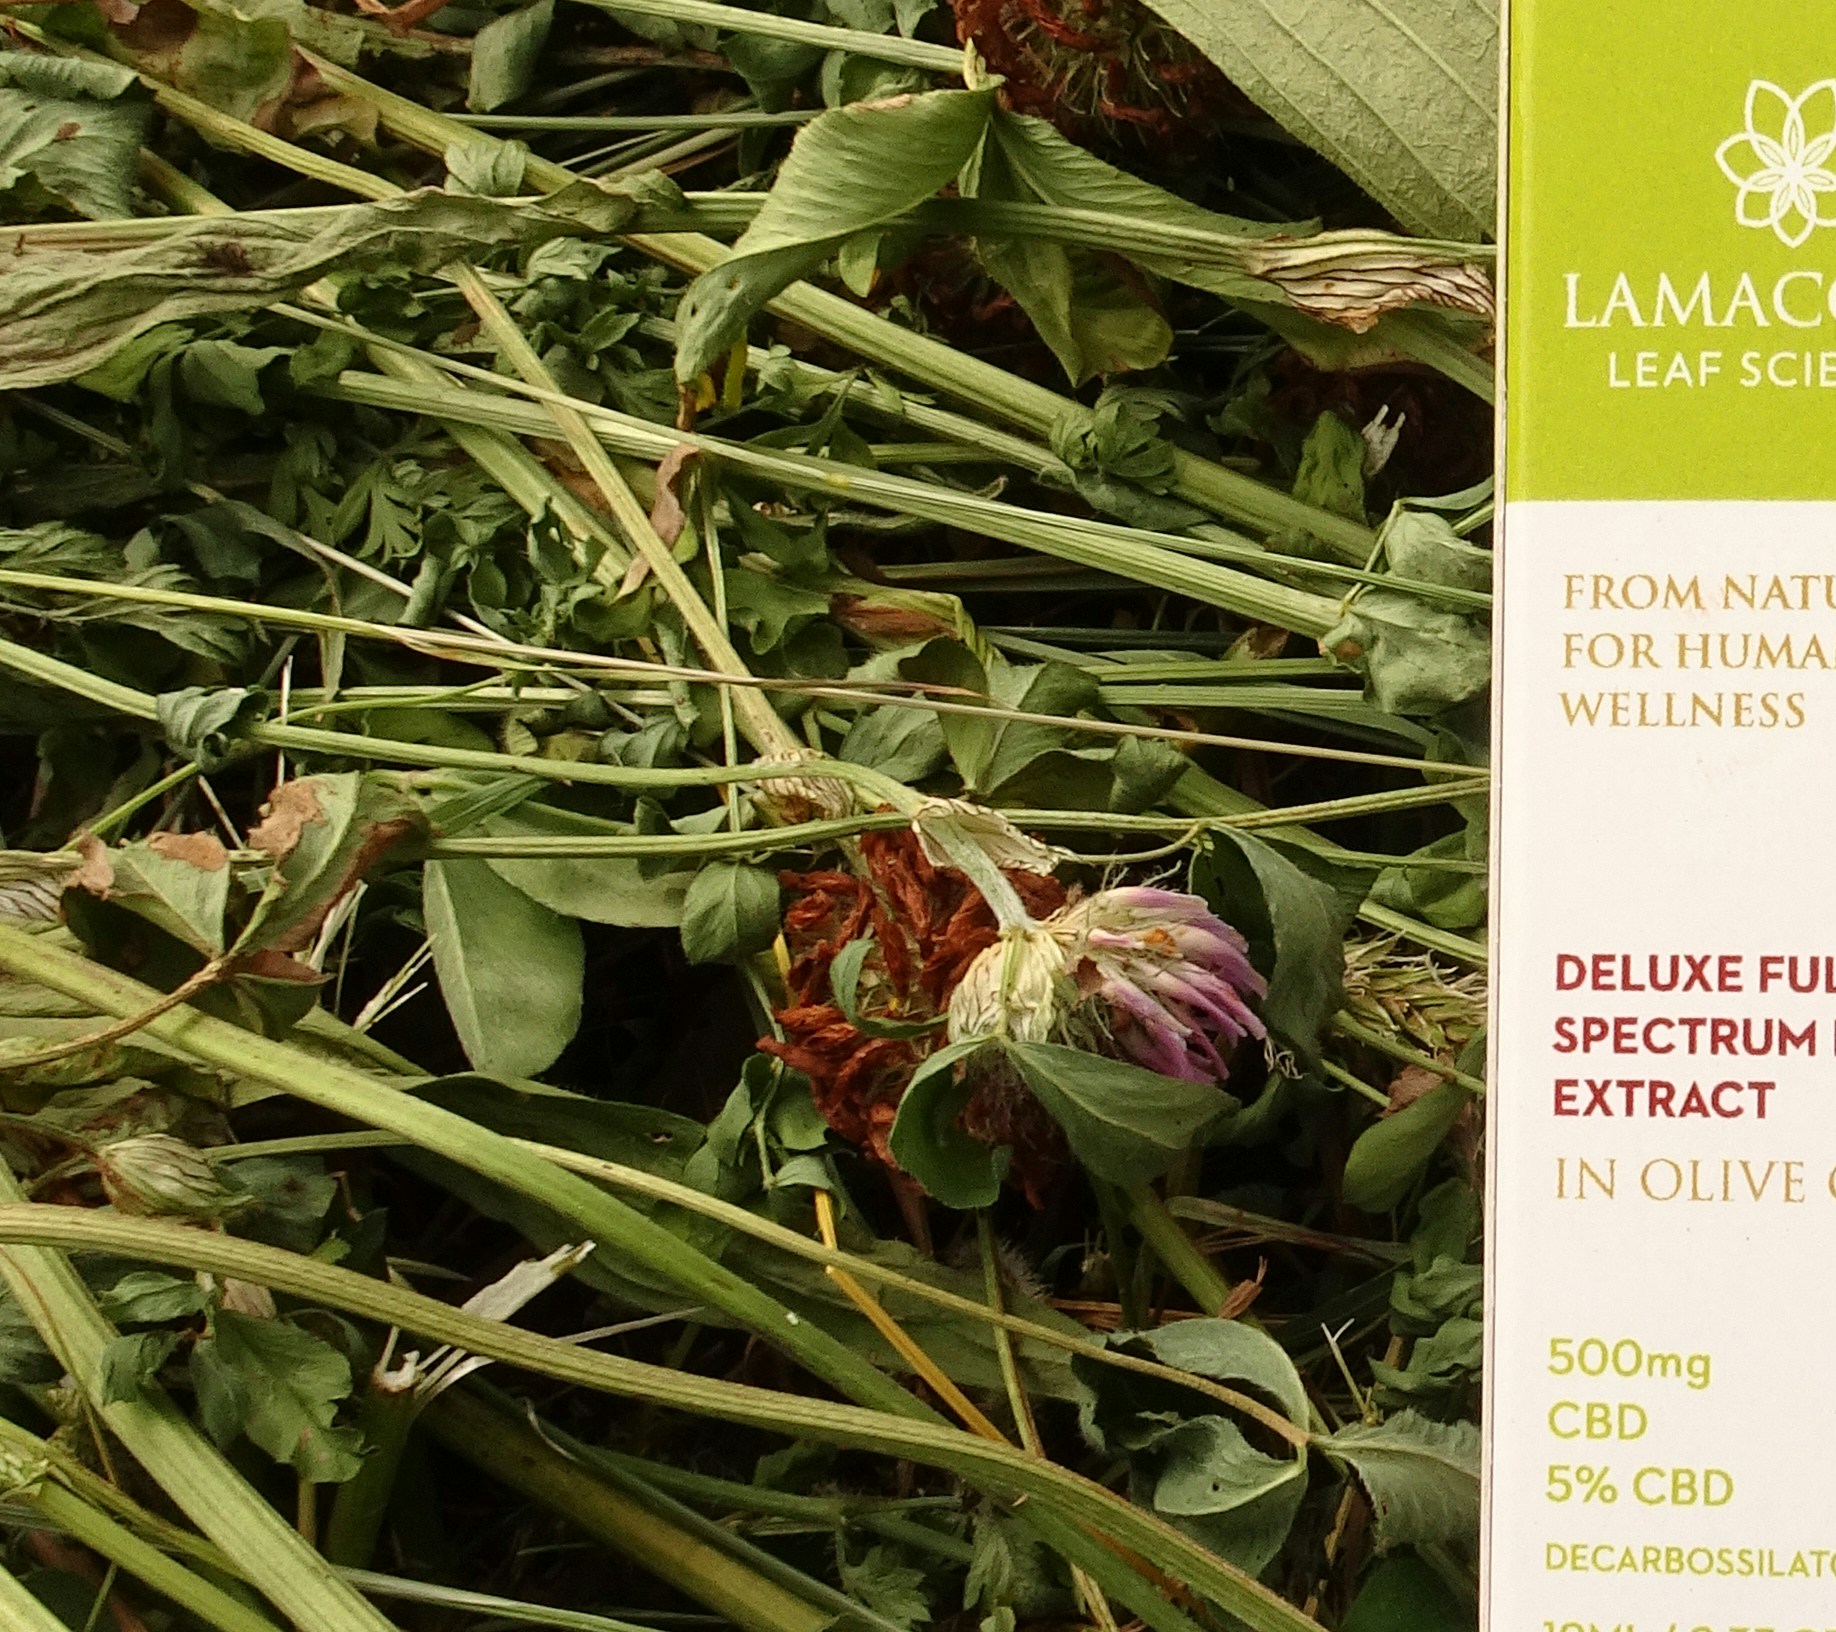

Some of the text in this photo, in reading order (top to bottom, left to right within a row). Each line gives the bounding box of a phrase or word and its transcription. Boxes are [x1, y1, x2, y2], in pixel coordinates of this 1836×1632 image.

[1608, 349, 1723, 389] LEAF
[1565, 574, 1706, 611] FROM
[1564, 632, 1660, 669] FOR
[1560, 691, 1806, 729] WELLNESS
[1556, 953, 1743, 992] DELUXE
[1553, 1016, 1817, 1057] SPECTRUM
[1554, 1078, 1776, 1119] EXTRACT
[1556, 1156, 1616, 1200] IN
[1639, 1158, 1806, 1204] OLIVE
[1548, 1337, 1712, 1391] 500mg
[1547, 1400, 1649, 1441] CBD
[1546, 1464, 1735, 1507] 5% CBD
